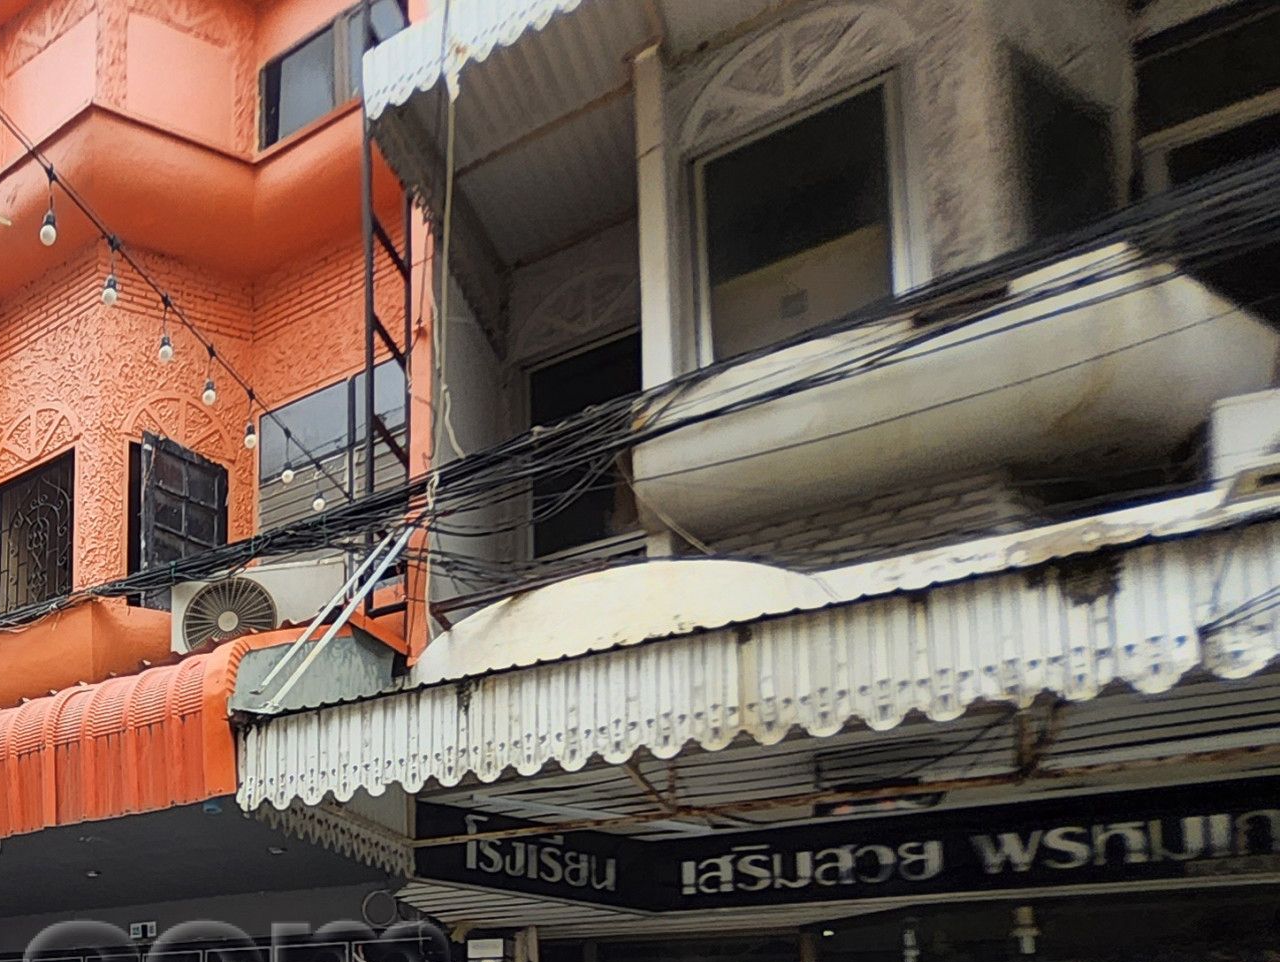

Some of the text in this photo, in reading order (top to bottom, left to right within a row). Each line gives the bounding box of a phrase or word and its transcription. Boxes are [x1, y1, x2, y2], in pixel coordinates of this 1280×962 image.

[464, 814, 616, 891] โรงเรียน
[680, 839, 945, 896] เสริมสวย
